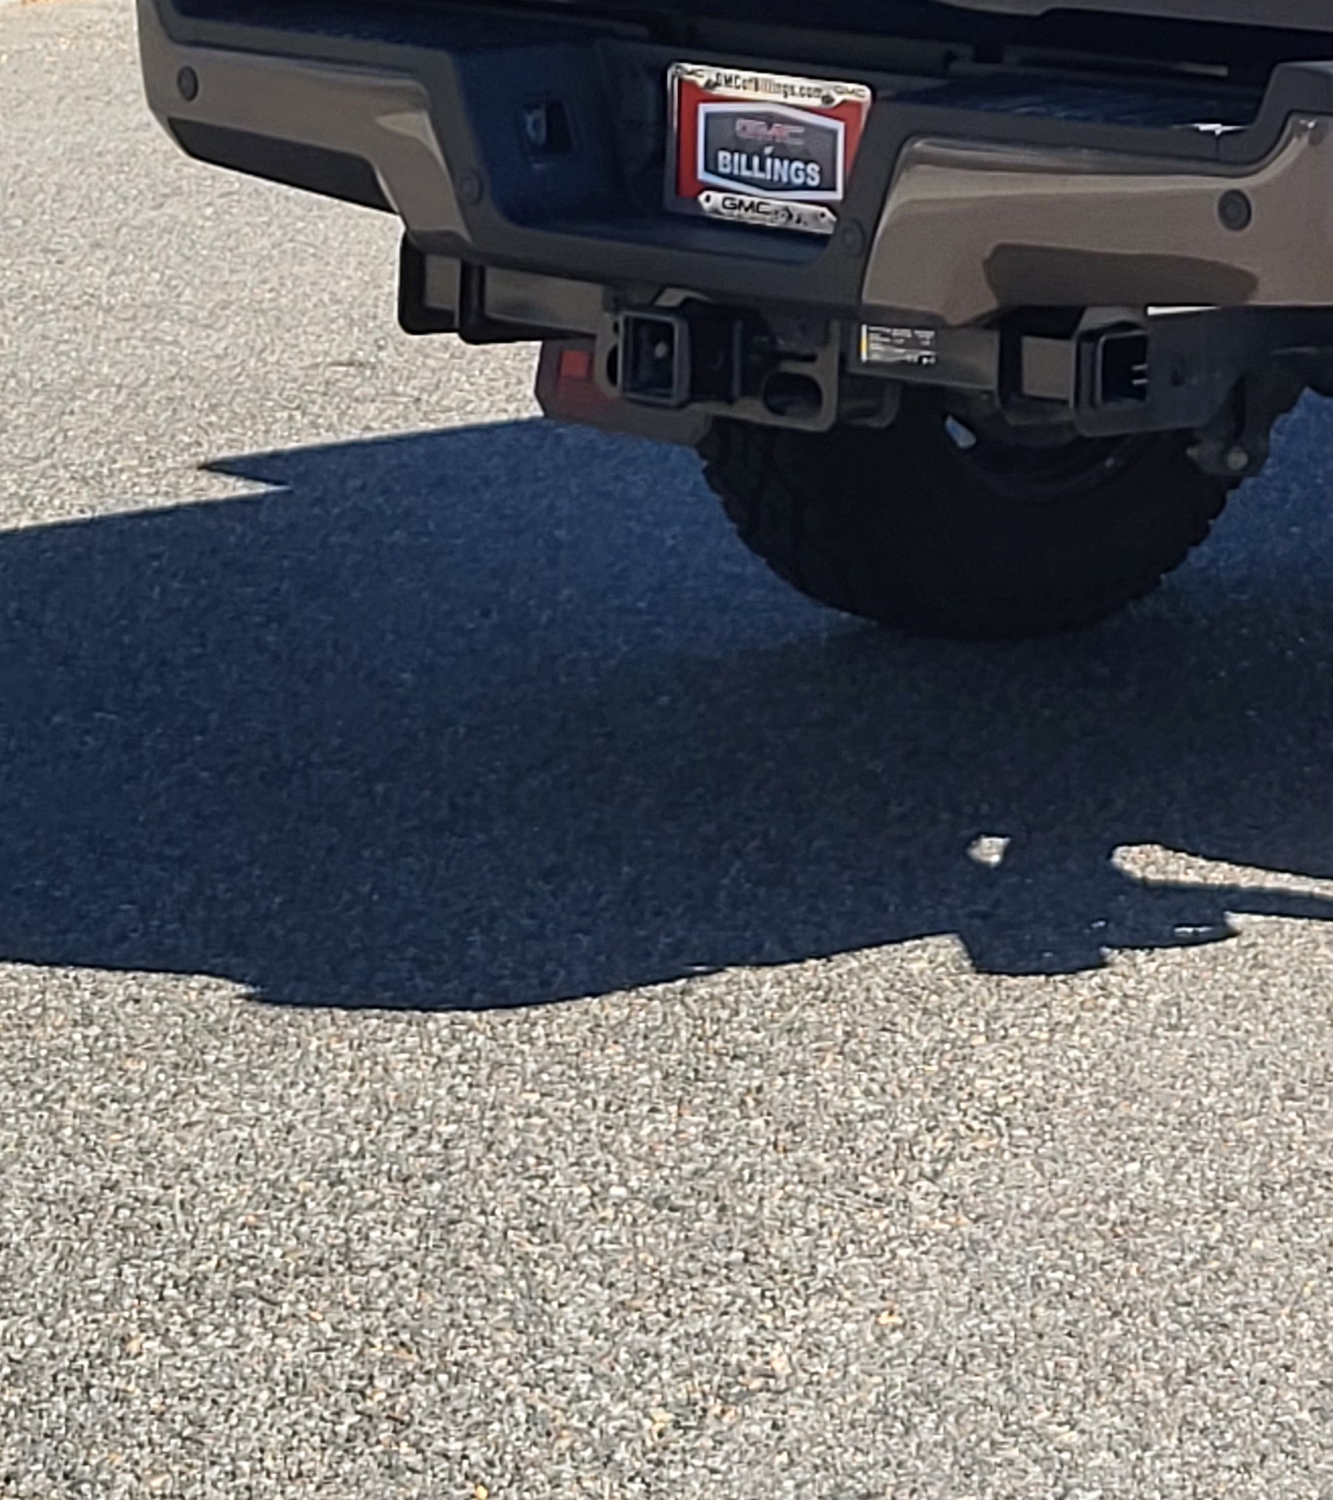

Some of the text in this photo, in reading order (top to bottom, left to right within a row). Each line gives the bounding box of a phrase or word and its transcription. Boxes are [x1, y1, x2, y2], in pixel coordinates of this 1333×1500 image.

[735, 118, 805, 145] GMC
[716, 148, 821, 187] BILLINGS
[721, 196, 773, 216] GMC
